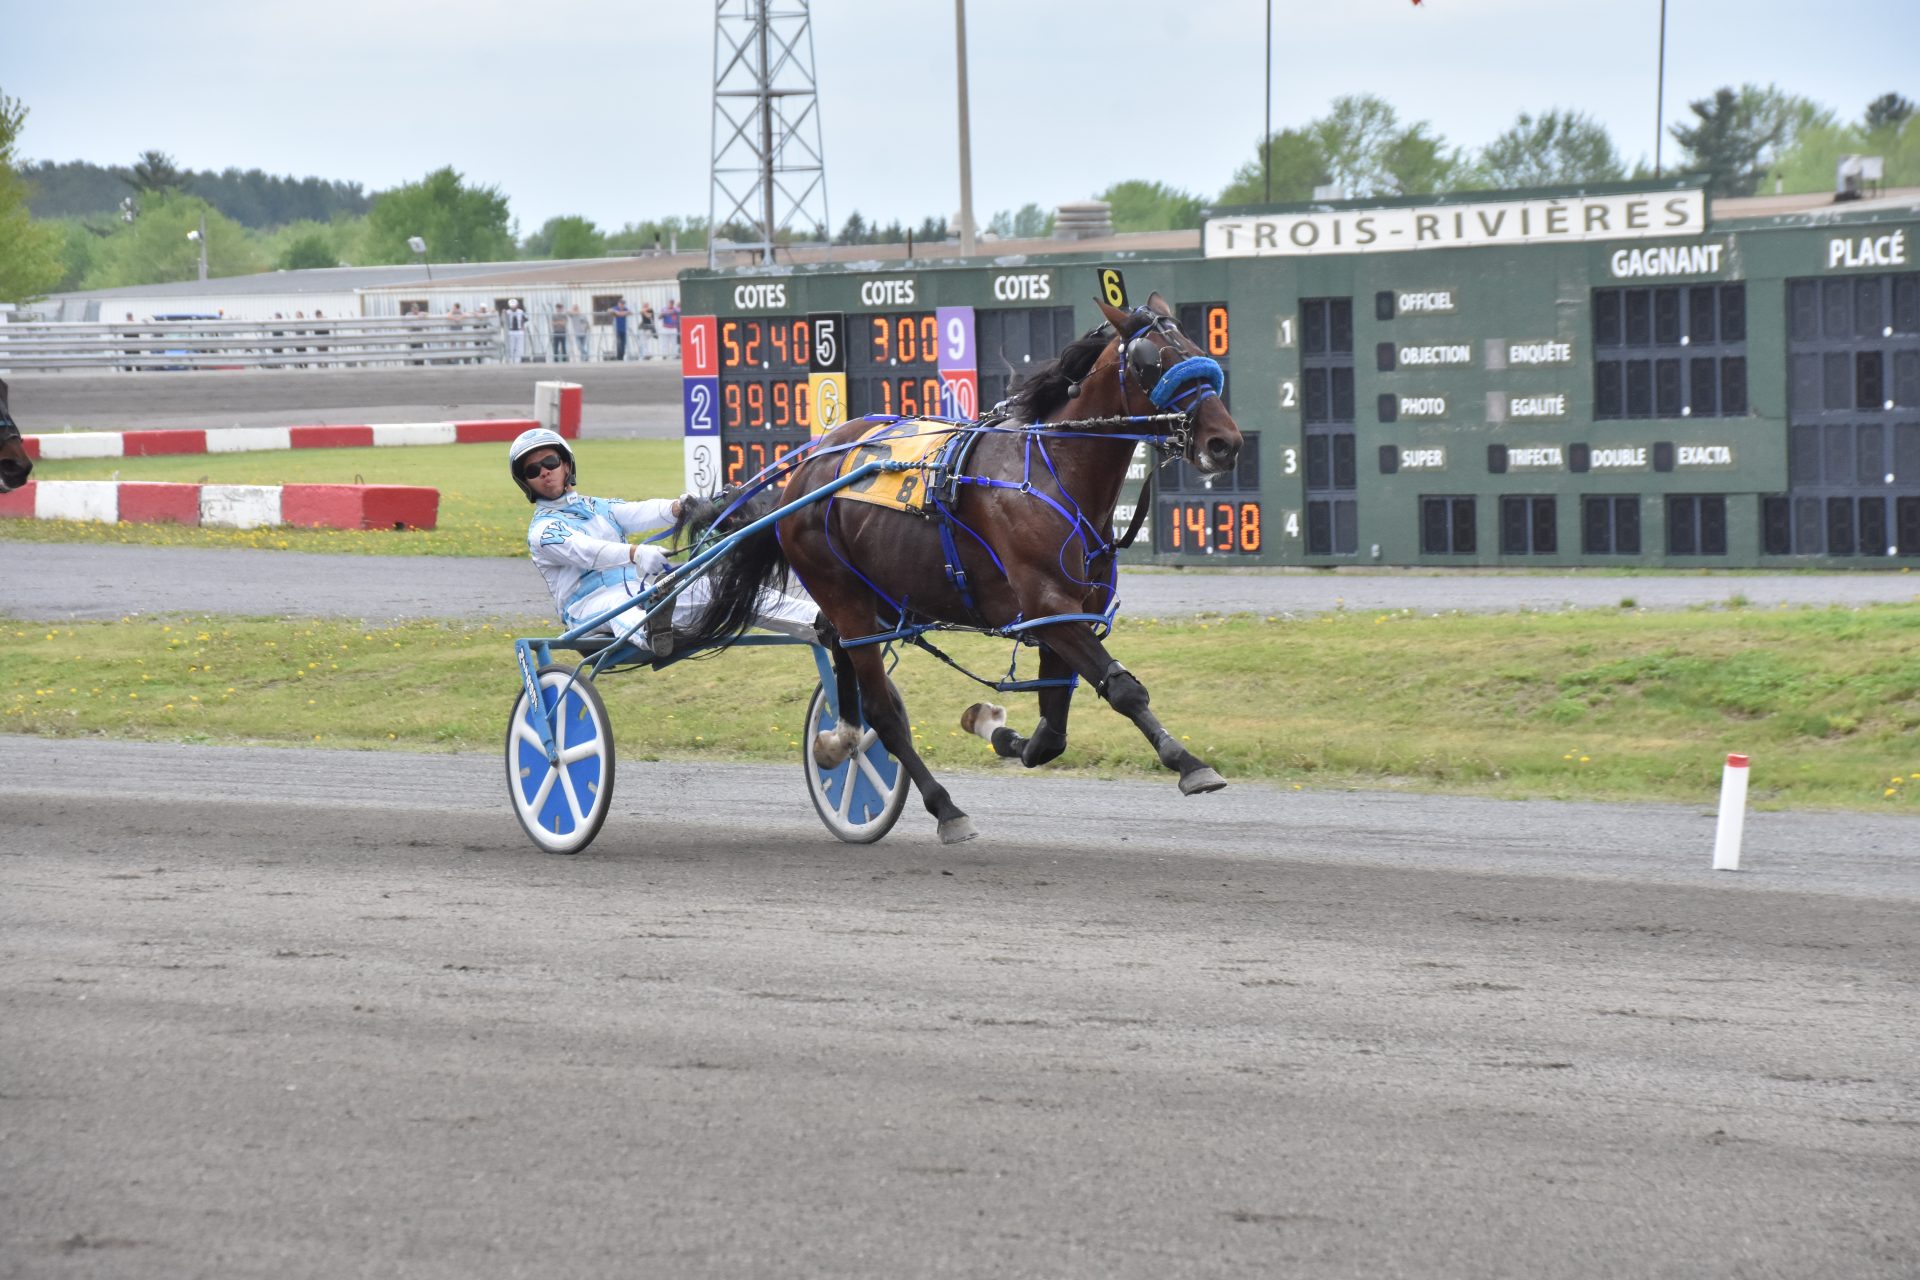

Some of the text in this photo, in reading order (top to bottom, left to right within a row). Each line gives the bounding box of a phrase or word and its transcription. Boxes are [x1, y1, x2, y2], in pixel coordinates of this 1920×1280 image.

[1219, 197, 1690, 249] TROIS-RIVIÈRES
[1611, 245, 1722, 278] GAGNANT
[1829, 229, 1905, 268] PLACÉ
[734, 284, 786, 309] COTES
[861, 280, 914, 305] COTES
[994, 274, 1050, 301] COTES
[1103, 269, 1124, 308] 6
[1399, 292, 1454, 313] OFFICIEL
[723, 321, 810, 368] 52.40
[815, 320, 836, 366] 5
[947, 317, 965, 360] 9
[1208, 307, 1229, 356] 8
[1282, 319, 1292, 344] 1
[690, 324, 706, 369] 1
[1400, 345, 1470, 364] OBJECTION
[1509, 341, 1571, 364] ENQUÊTE
[691, 384, 711, 429] 2
[818, 378, 840, 431] 6
[941, 378, 975, 420] 10
[1282, 382, 1295, 407] 2
[1401, 398, 1445, 415] PHOTO
[1511, 395, 1565, 416] EGALITÉ
[693, 444, 712, 489] 3
[1284, 448, 1297, 474] 3
[1402, 450, 1443, 467] SUPER
[1508, 448, 1563, 466] TRIFECTA
[1591, 448, 1646, 467] DOUBLE
[1679, 446, 1731, 465] EXACTA
[896, 475, 918, 503] 8
[540, 520, 573, 548] W
[1172, 503, 1260, 551] 14:38
[1285, 513, 1299, 538] 4
